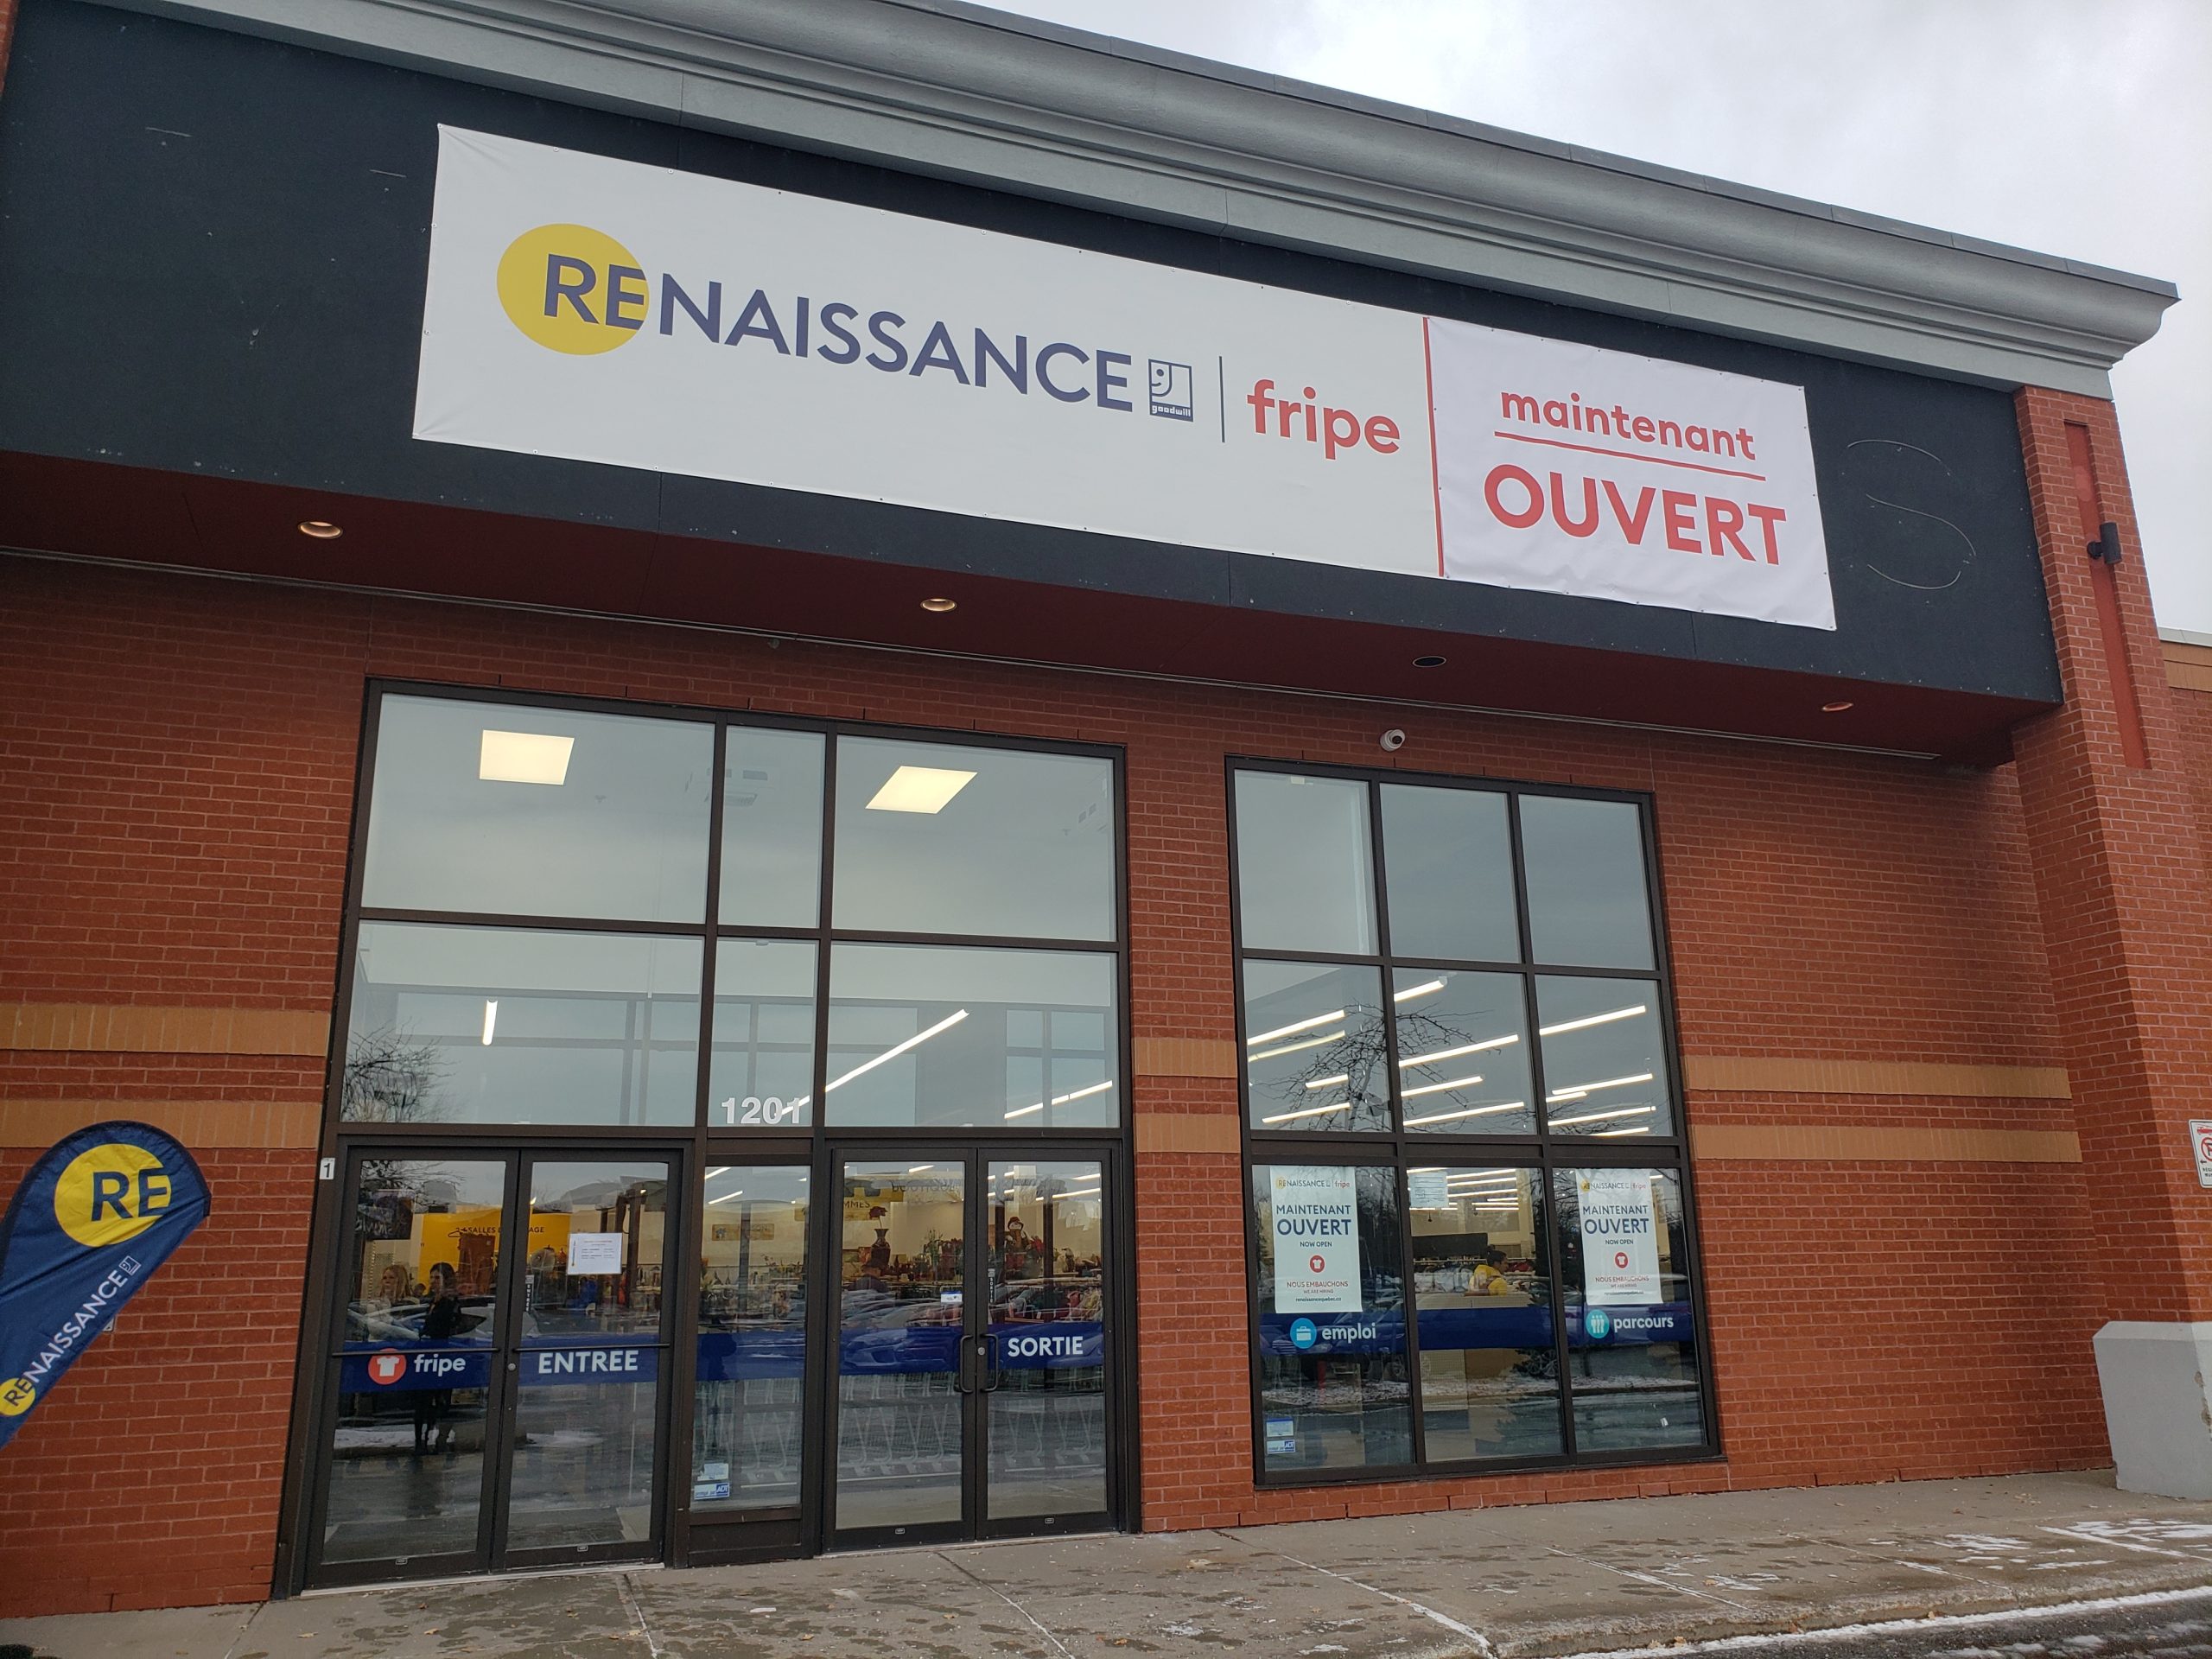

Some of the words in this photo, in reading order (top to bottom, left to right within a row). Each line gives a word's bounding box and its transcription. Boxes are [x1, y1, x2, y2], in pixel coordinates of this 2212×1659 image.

[543, 252, 1134, 413] RENAISSANCE
[1151, 404, 1192, 417] goodwill
[1246, 378, 1401, 460] fripe
[1501, 391, 1757, 461] maintenant
[1484, 464, 1787, 565] OUVERT
[721, 1096, 801, 1125] 1201
[323, 1162, 331, 1178] 1
[91, 1166, 171, 1222] RE
[1276, 1205, 1351, 1215] MAINTENANT
[1582, 1205, 1649, 1216] MAINTENANT
[1276, 1218, 1351, 1236] OUVERT
[1584, 1217, 1649, 1235] OUVERT
[1321, 1323, 1376, 1344] emploi
[1613, 1317, 1675, 1333] parcours
[3, 1269, 128, 1408] RENAISSANCE
[1007, 1336, 1084, 1357] SORTIE
[414, 1353, 467, 1377] fripe
[538, 1350, 639, 1374] ENTREE
